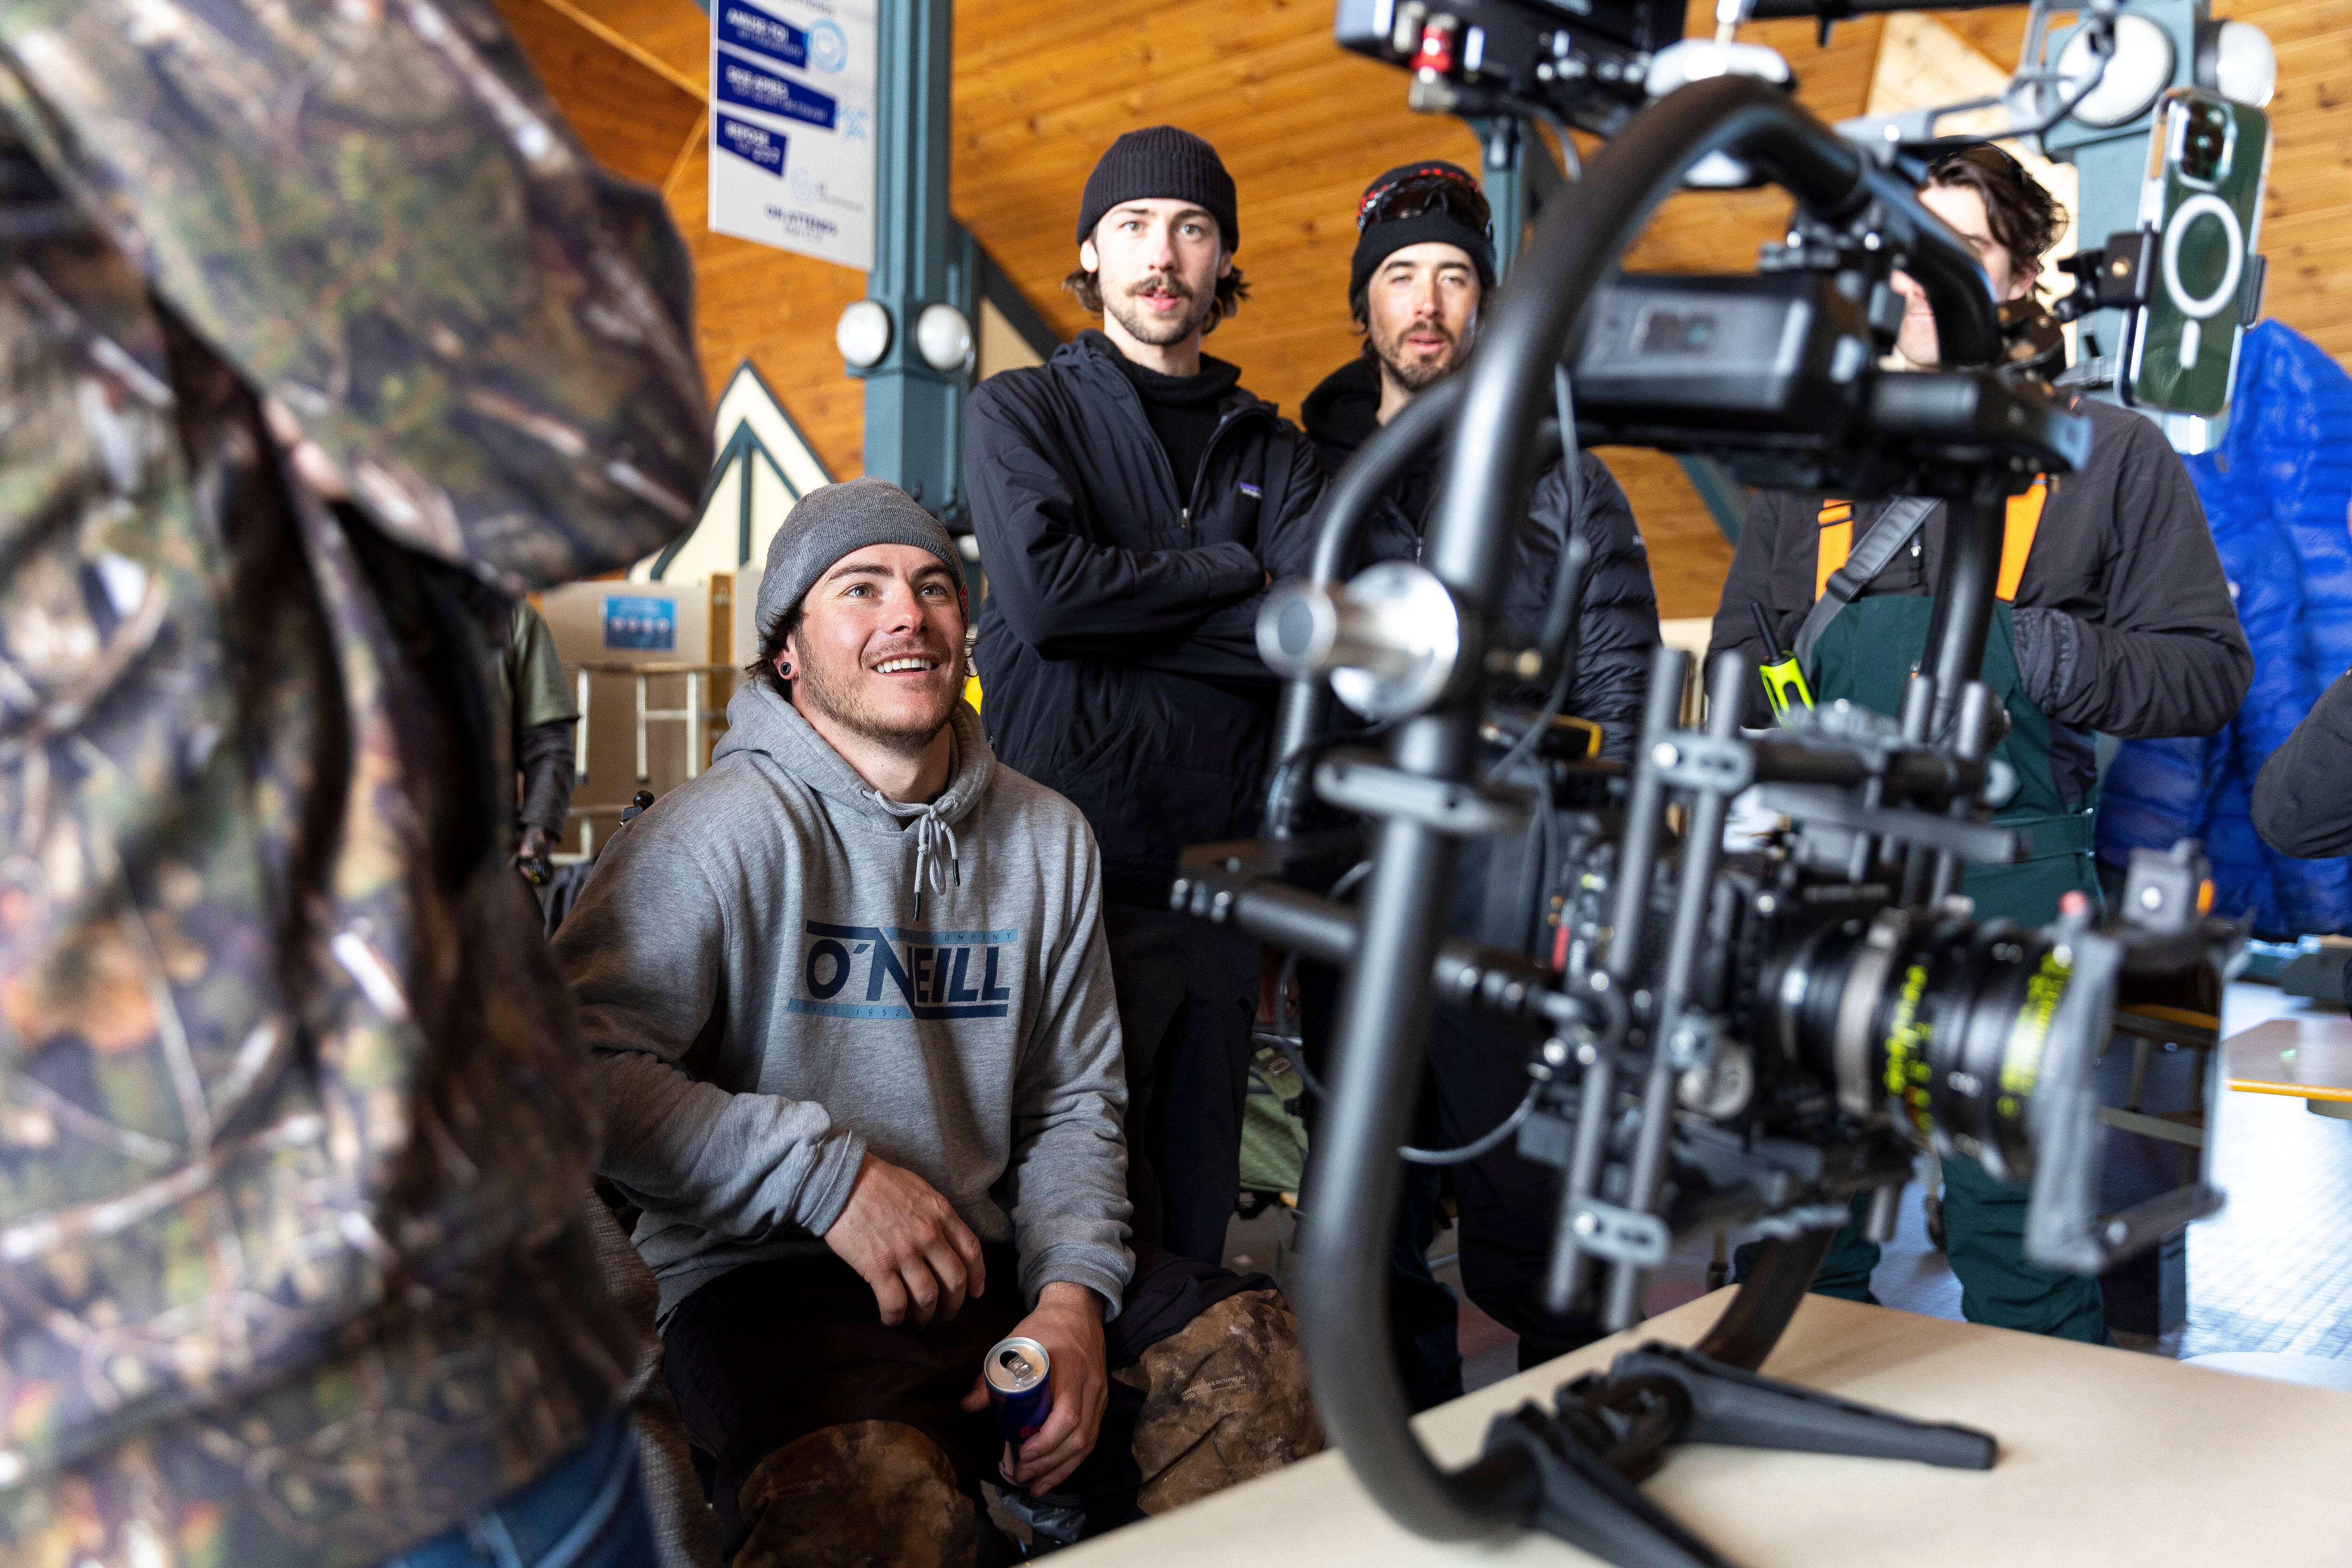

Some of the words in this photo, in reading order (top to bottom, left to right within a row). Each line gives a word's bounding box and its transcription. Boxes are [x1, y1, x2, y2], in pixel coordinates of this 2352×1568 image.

[932, 932, 1011, 941] COMPANY
[806, 920, 1010, 1019] O'NEILL
[795, 1002, 837, 1014] SINCE
[856, 1008, 901, 1017] 1952
[1182, 1382, 1215, 1396] PERFOCE
[1216, 1375, 1246, 1385] OUTERWEAR
